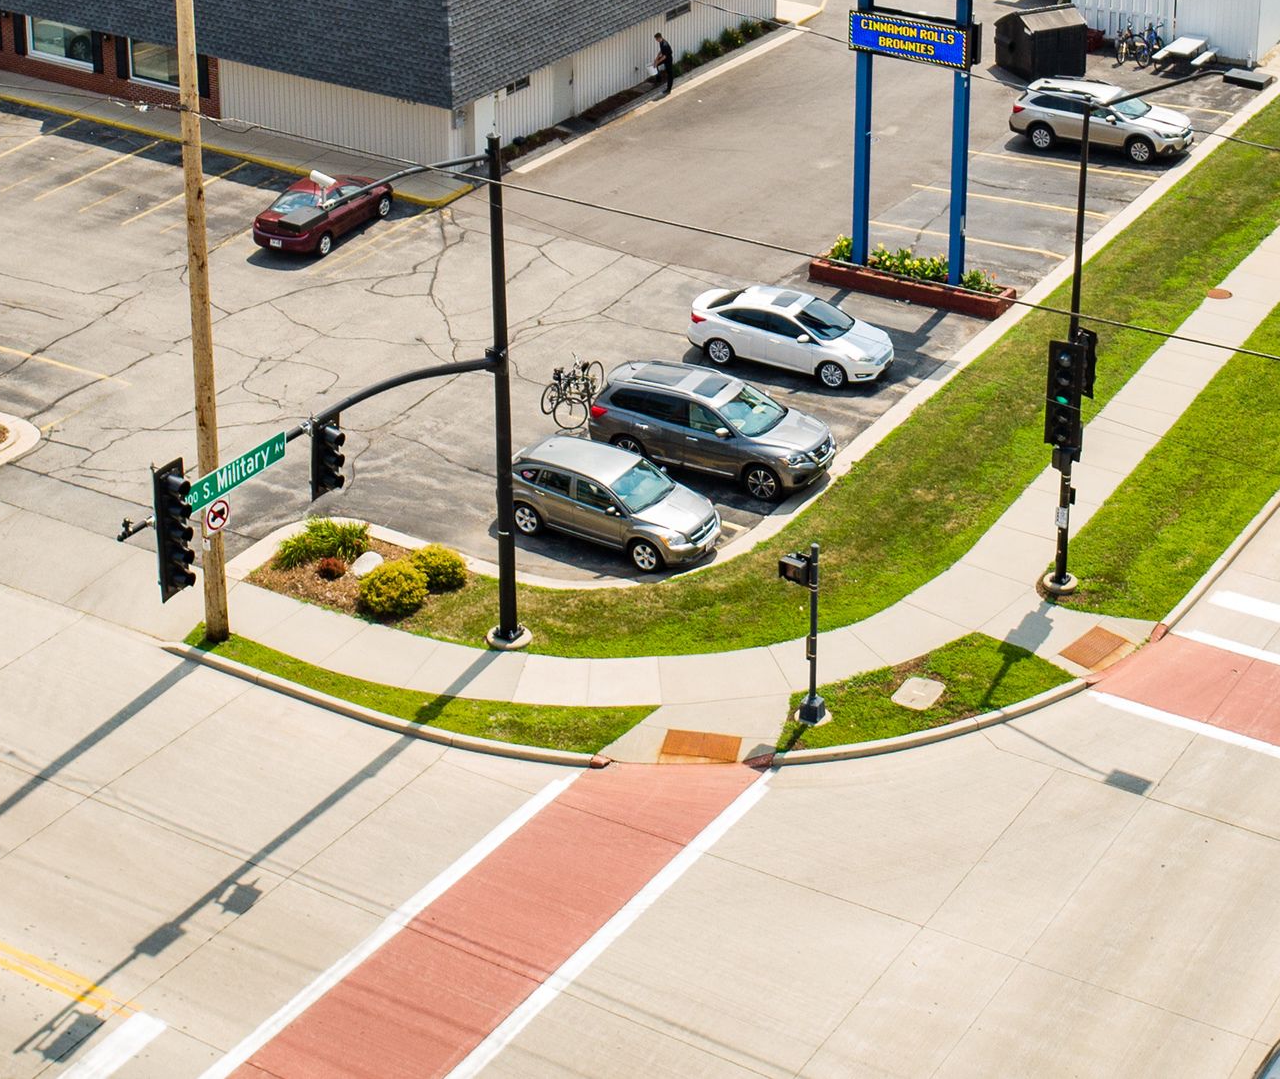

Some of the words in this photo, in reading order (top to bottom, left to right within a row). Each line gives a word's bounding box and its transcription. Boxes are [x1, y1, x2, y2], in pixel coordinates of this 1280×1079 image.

[860, 18, 918, 38] CINNAMON
[919, 29, 955, 45] ROLLS
[878, 36, 935, 56] BROWNIES
[202, 482, 214, 499] S.
[216, 446, 270, 493] Military
